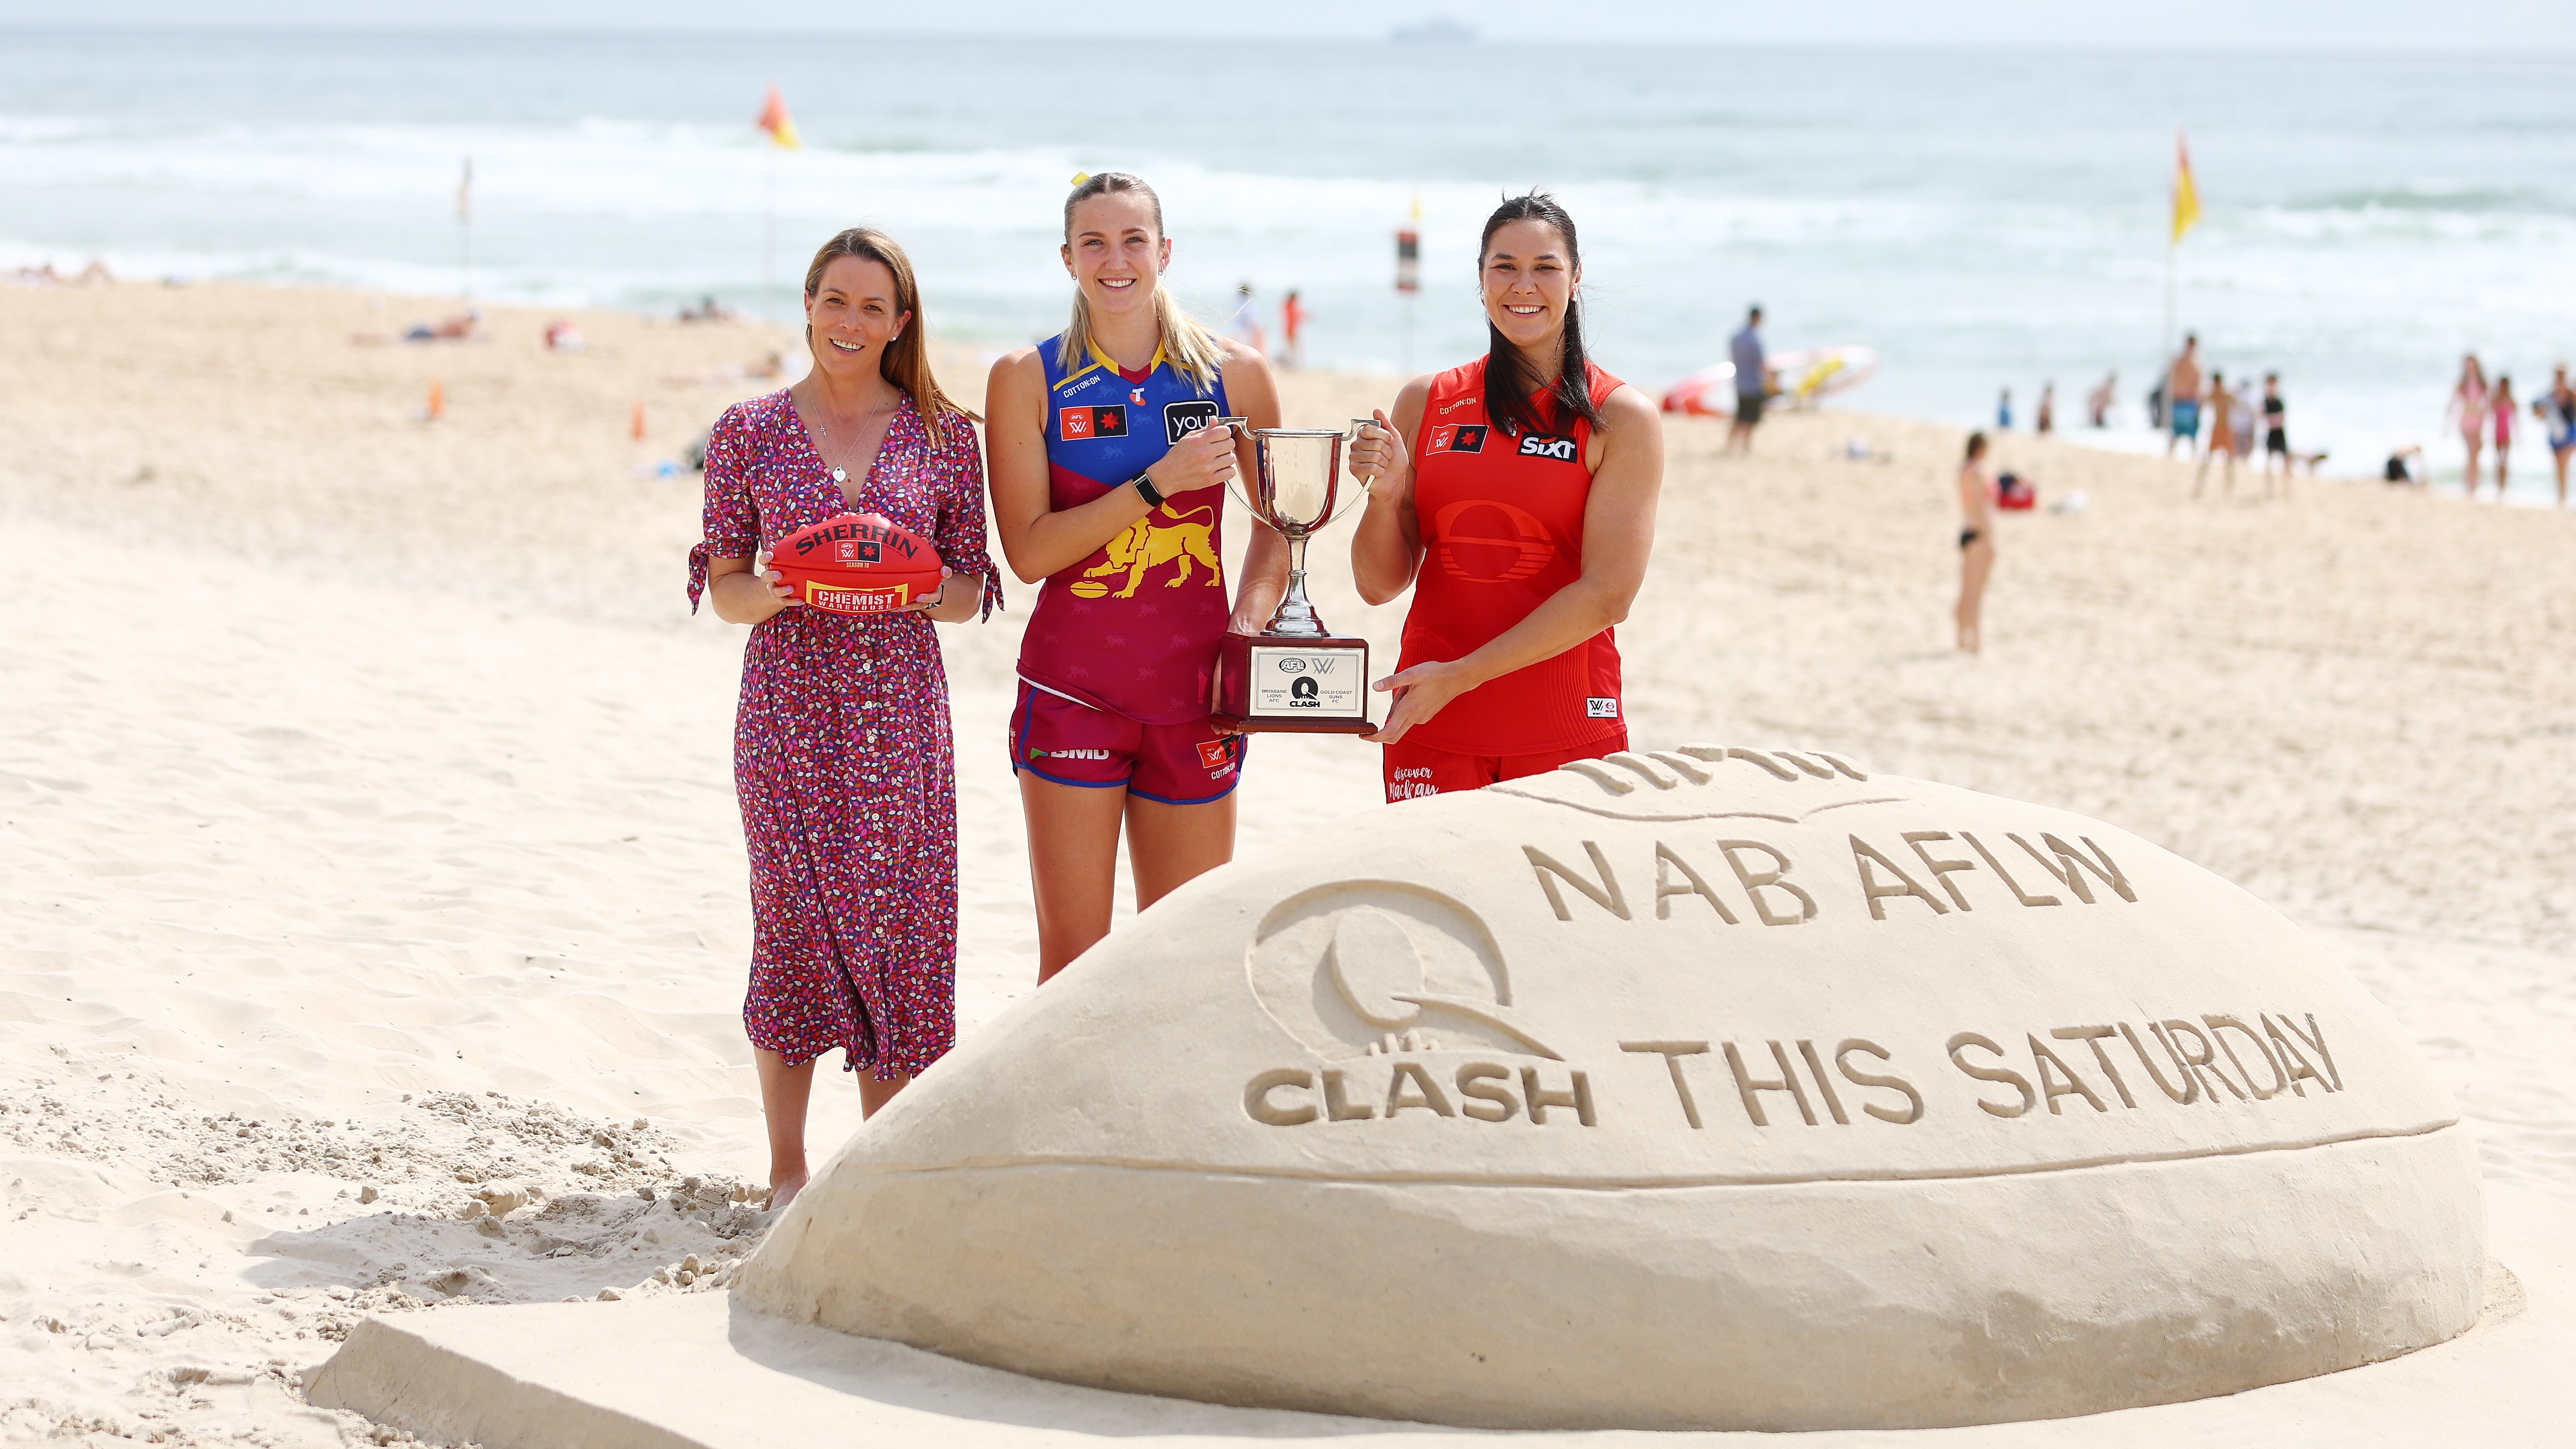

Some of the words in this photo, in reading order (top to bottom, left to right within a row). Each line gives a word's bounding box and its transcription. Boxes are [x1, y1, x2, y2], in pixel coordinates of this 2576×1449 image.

[795, 523, 919, 559] SHERRIN
[818, 591, 895, 605] CHEMIST
[818, 600, 892, 611] WAREHOUSE
[1281, 661, 1304, 670] AFL
[1291, 676, 1318, 701] Q
[1394, 766, 1433, 782] discover
[1521, 837, 1819, 926] NAB
[1849, 831, 2138, 920] AFLW
[1244, 878, 1567, 1063] Q
[1618, 1038, 1925, 1130] THIS
[1946, 1011, 2344, 1119] SATURDAY
[1242, 1062, 1598, 1127] CLASH
